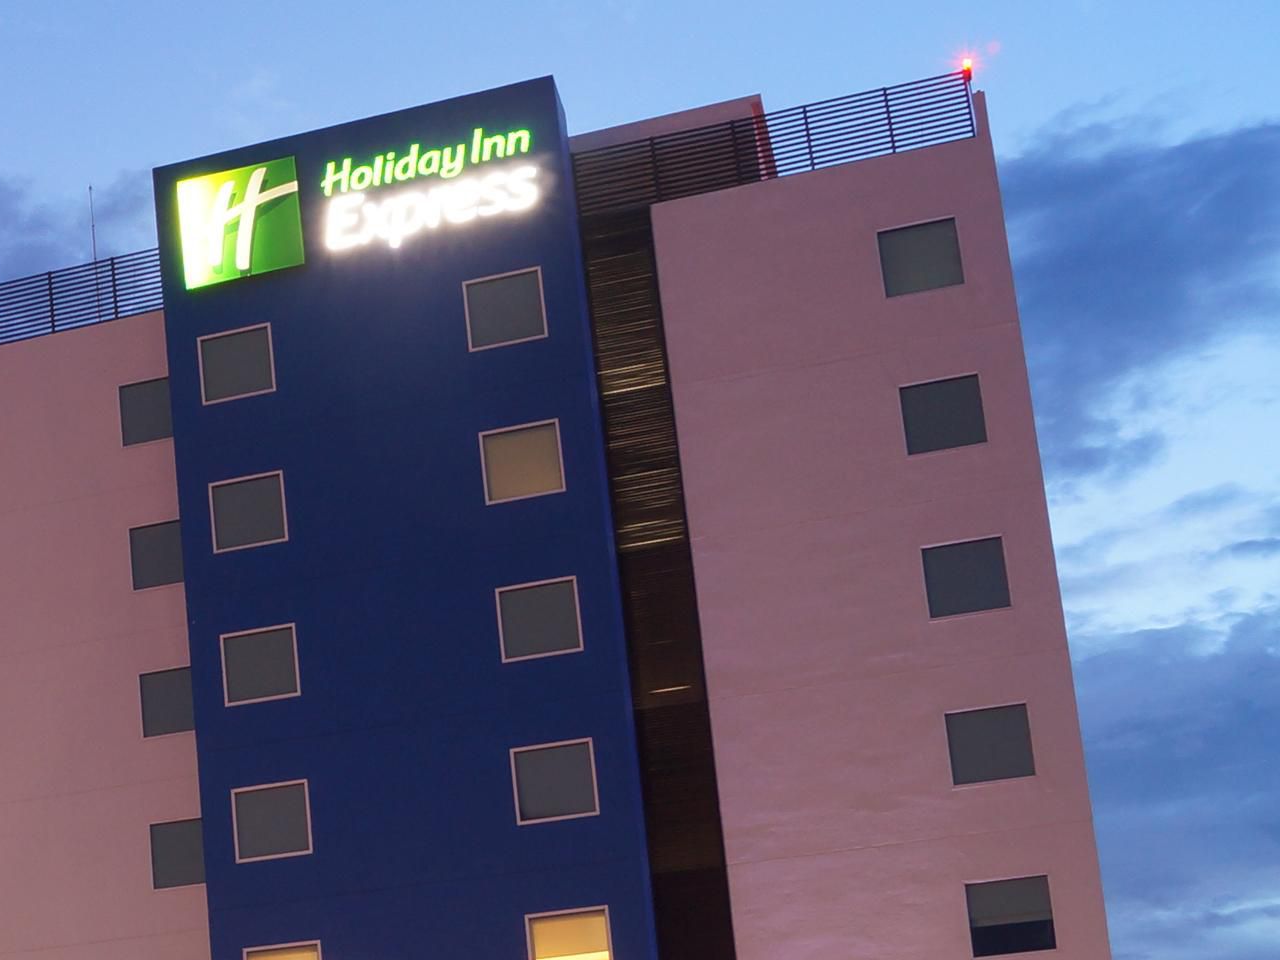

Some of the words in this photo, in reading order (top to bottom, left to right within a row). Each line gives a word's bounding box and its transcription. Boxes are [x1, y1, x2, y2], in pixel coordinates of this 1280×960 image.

[321, 144, 465, 197] Holiday
[471, 128, 530, 164] Inn
[325, 166, 538, 250] Express
